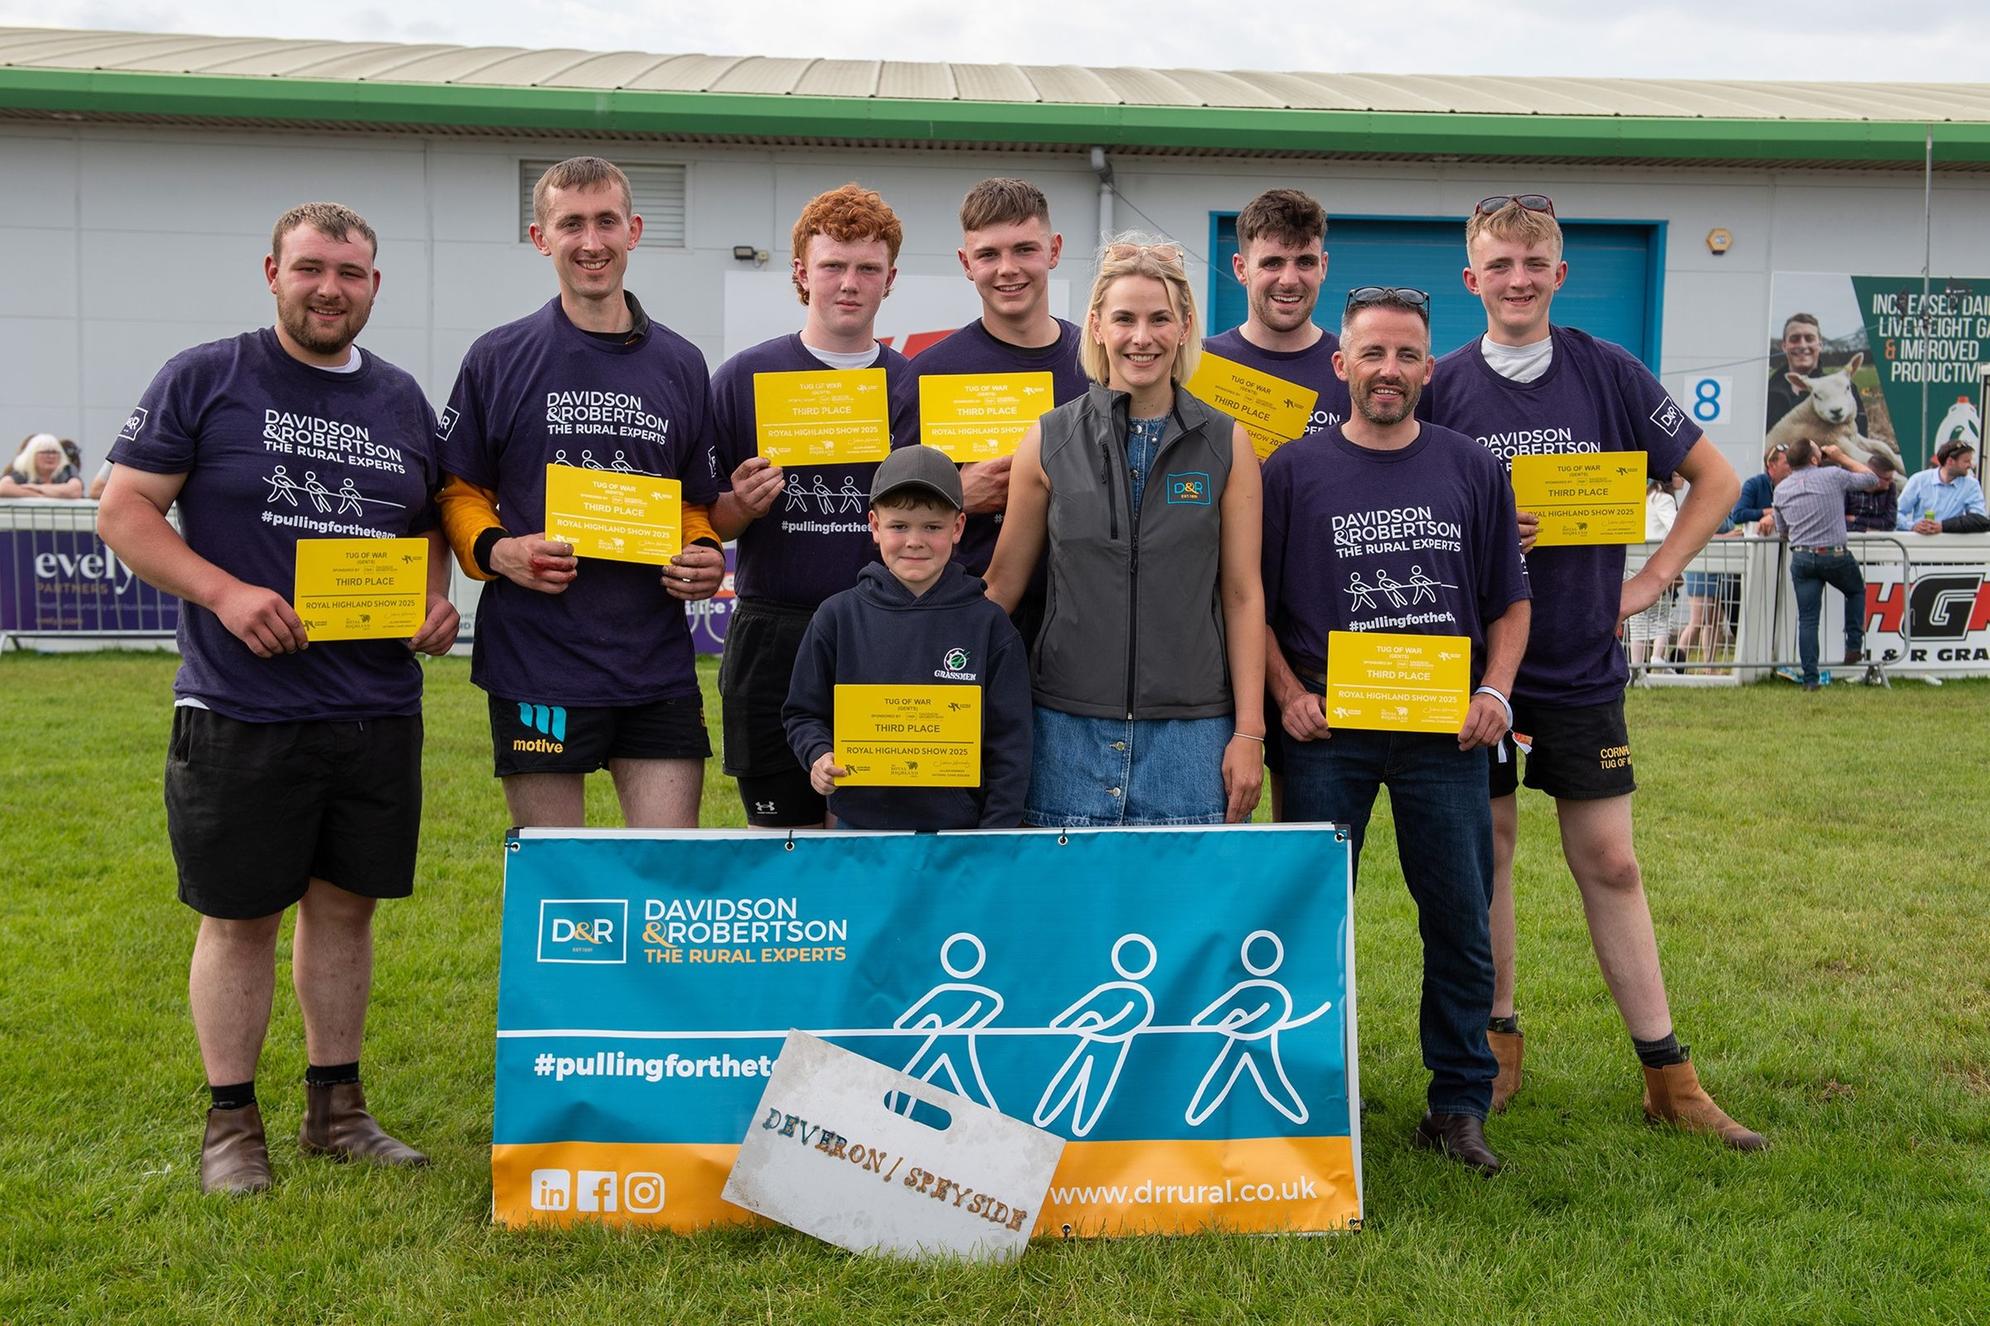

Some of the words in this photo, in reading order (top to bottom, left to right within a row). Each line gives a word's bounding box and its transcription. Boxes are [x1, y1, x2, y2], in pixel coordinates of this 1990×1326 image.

[1884, 339, 1896, 360] &
[1900, 340, 1980, 361] IMPROVED
[1231, 375, 1245, 386] TUG
[1256, 384, 1272, 395] WAR
[547, 391, 641, 410] DAVIDSON
[1214, 395, 1240, 410] THIRD
[1241, 405, 1270, 422] PLACE
[1694, 378, 1720, 422] 8
[546, 406, 669, 433] &ROBERTSON
[793, 407, 819, 416] THIRD
[821, 406, 851, 414] PLACE
[957, 408, 984, 416] THIRD
[265, 409, 369, 441] DAVIDSON
[547, 424, 572, 434] THE
[576, 424, 617, 435] RURAL
[620, 426, 666, 445] EXPERTS
[769, 429, 793, 437] ROYAL
[794, 428, 835, 436] HIGHLAND
[263, 424, 402, 462] &ROBERTSON
[1270, 438, 1287, 448] 202
[264, 441, 293, 453] THE
[297, 446, 344, 463] RURAL
[349, 455, 406, 474] EXPERTS
[592, 481, 607, 489] TUG
[1174, 481, 1203, 495] D&R
[584, 502, 612, 513] THIRD
[614, 506, 644, 517] PLACE
[1331, 506, 1432, 531] DAVIDSON
[261, 511, 396, 538] #pullingfortheteam
[557, 519, 582, 528] ROYAL
[584, 523, 625, 534] HIGHLAND
[628, 528, 650, 536] SHOW
[1334, 520, 1462, 546] &ROBERTSON
[1336, 545, 1363, 559] THE
[1366, 541, 1410, 554] RURAL
[1412, 538, 1461, 552] EXPERTS
[336, 578, 362, 586] THIRD
[365, 577, 394, 585] PLACE
[1349, 611, 1456, 632] #pullingforthet
[1911, 649, 1927, 661] R
[934, 669, 976, 681] GRASSMEN
[1366, 670, 1396, 679] THIRD
[1398, 671, 1430, 680] PLACE
[1338, 690, 1364, 698] ROYAL
[1366, 692, 1410, 701] HIGHLAND
[875, 724, 904, 732] THIRD
[907, 724, 940, 733] PLACE
[513, 738, 564, 754] motive
[1600, 760, 1616, 769] TUG
[1617, 758, 1626, 767] OF
[644, 897, 797, 921] DAVIDSON
[552, 919, 614, 944] D&R
[642, 918, 847, 948] &ROBERTSON
[644, 949, 683, 964] THE
[689, 948, 756, 964] RURAL
[761, 947, 847, 962] EXPERTS
[534, 1051, 778, 1082] #pullingforthet
[1049, 1176, 1318, 1205] www.drrural.co.uk
